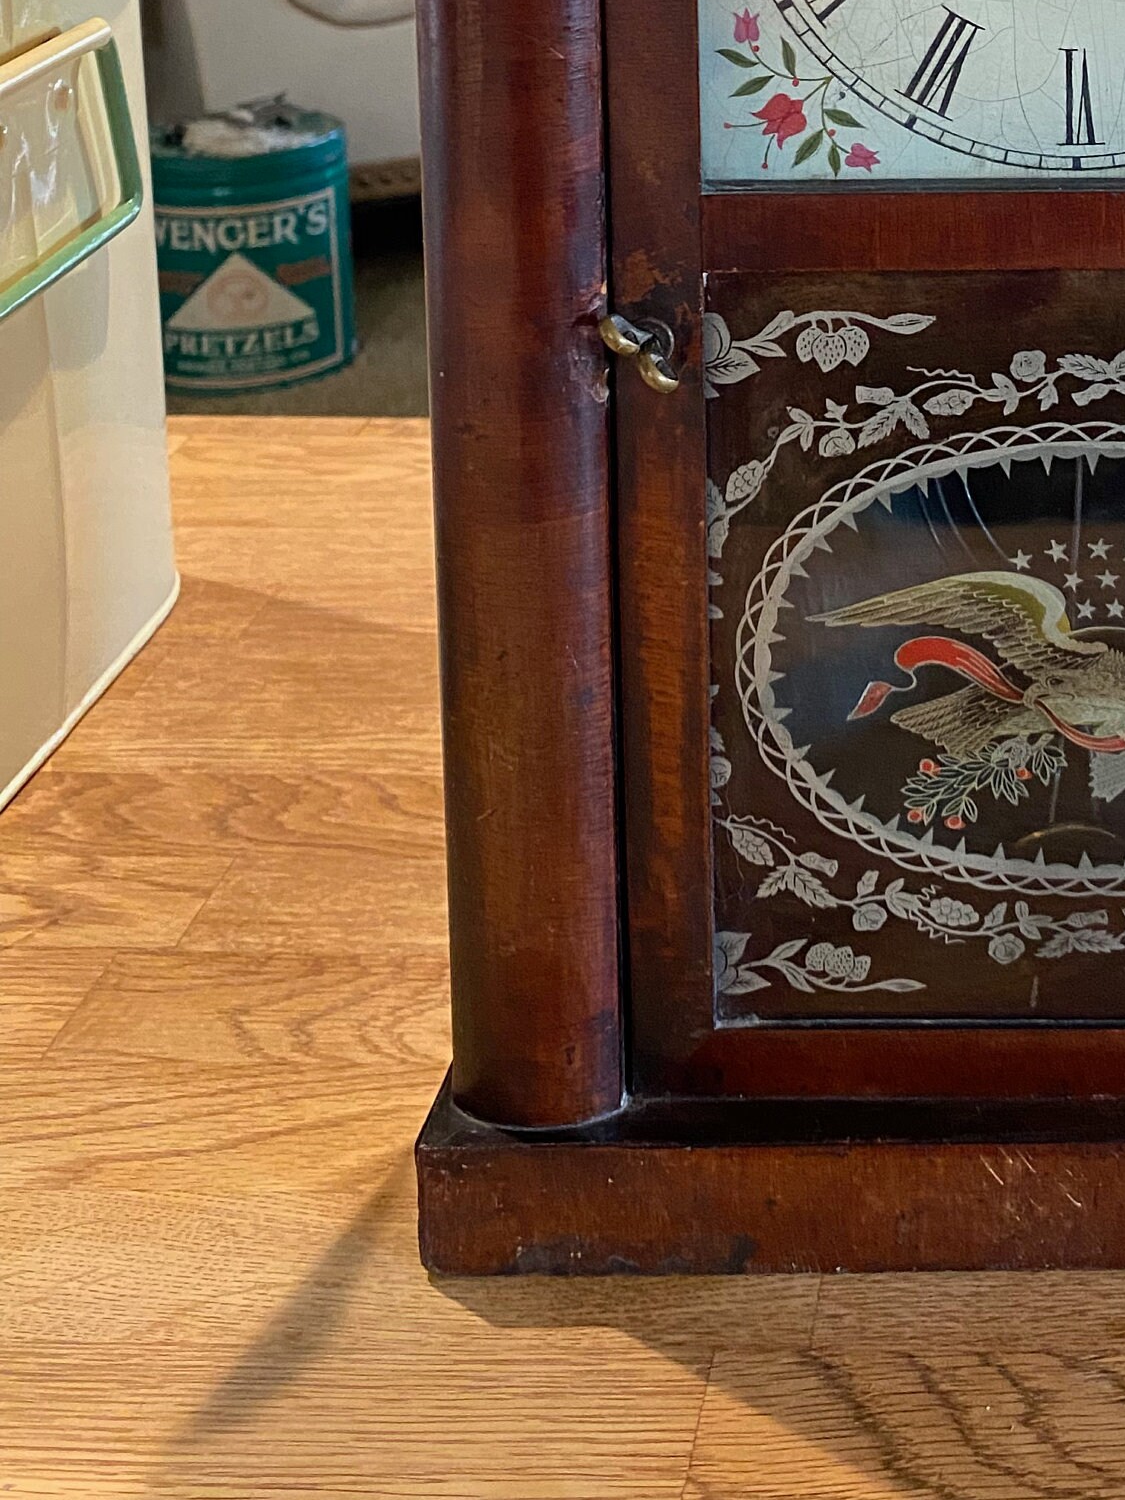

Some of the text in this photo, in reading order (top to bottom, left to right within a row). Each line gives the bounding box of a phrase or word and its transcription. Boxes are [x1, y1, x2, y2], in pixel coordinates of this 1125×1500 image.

[893, 4, 986, 121] VII
[1056, 48, 1106, 146] VI
[164, 321, 320, 358] PRETZELS
